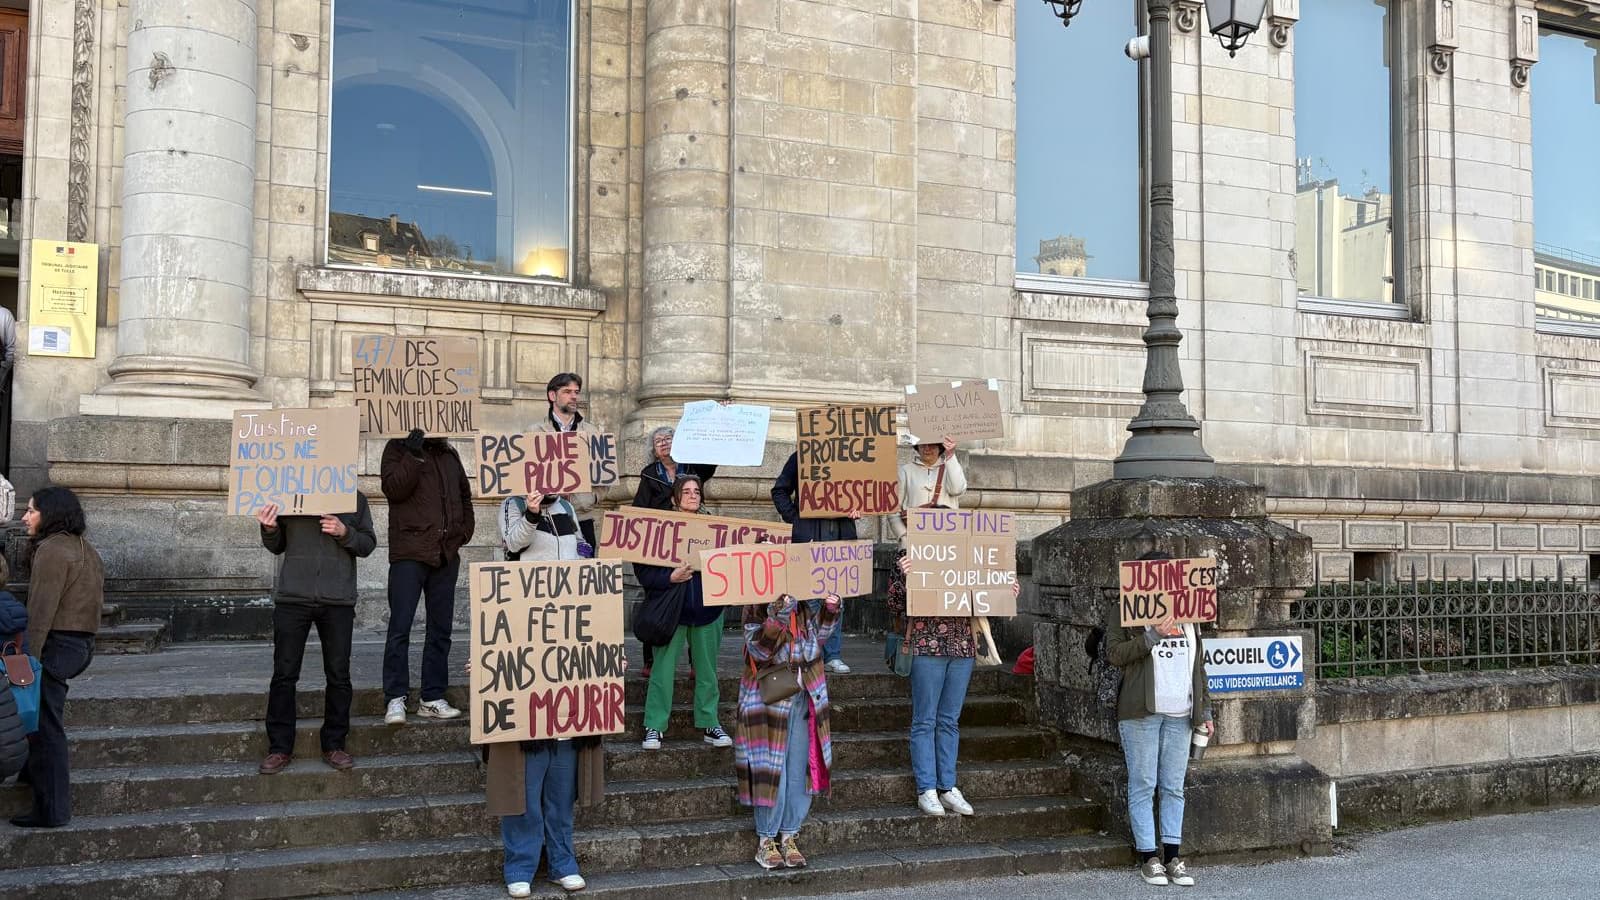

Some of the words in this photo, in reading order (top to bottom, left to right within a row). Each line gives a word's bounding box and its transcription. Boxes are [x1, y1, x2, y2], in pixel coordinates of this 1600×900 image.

[406, 340, 439, 367] DES
[934, 391, 985, 409] OLIVIA
[239, 413, 318, 439] Justine
[355, 399, 383, 434] EN
[387, 399, 433, 433] MILIEU
[437, 400, 480, 433] RURAL
[798, 409, 821, 437] LE
[238, 442, 285, 460] NOUS
[294, 439, 319, 459] NE
[481, 434, 526, 463] PAS
[535, 431, 579, 462] UNE
[591, 434, 616, 461] NE
[234, 463, 357, 494] T'OUBLIONS
[480, 462, 512, 494] DE
[524, 460, 582, 495] PLUS
[590, 460, 617, 485] US
[800, 465, 832, 481] LES
[235, 490, 286, 516] PAS
[800, 479, 899, 513] AGRESSEURS
[914, 511, 1011, 533] JUSTINE
[687, 538, 711, 554] pour
[910, 543, 958, 562] NOUS
[973, 546, 999, 565] NE
[480, 566, 511, 604] JE
[519, 565, 572, 599] VEUX
[706, 550, 786, 598] STOP
[811, 565, 860, 595] 3919
[1121, 559, 1191, 592] JUSTINE
[943, 591, 991, 614] PAS
[1123, 592, 1168, 622] NOUS
[1167, 587, 1217, 621] TOUTES
[480, 609, 512, 646] LA
[527, 602, 593, 644] FÊTE
[1158, 650, 1174, 659] CO
[1204, 647, 1265, 666] ACCUEIL
[478, 646, 536, 694] SANS
[1208, 678, 1224, 690] OUS
[483, 698, 516, 735] DE
